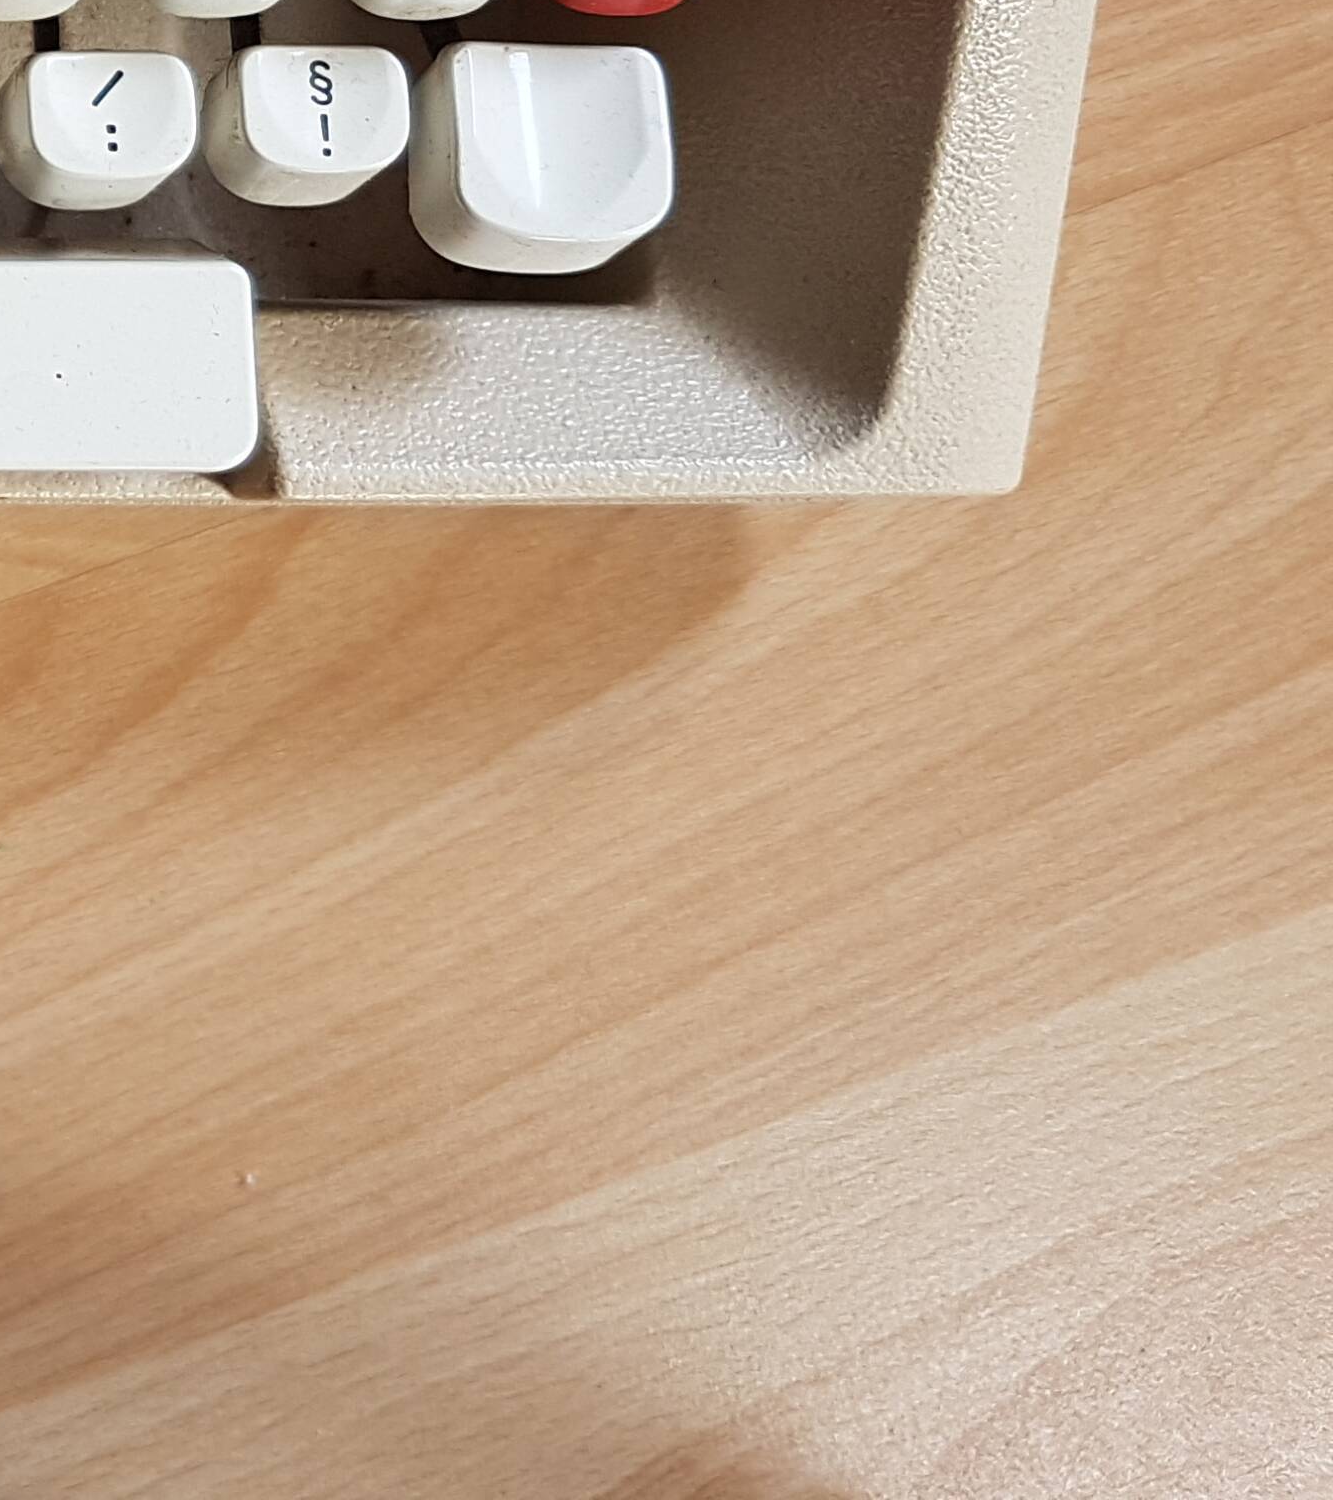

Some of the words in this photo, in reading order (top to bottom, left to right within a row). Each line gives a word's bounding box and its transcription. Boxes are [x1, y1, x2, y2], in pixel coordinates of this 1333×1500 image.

[92, 70, 124, 107] /
[309, 59, 333, 106] §
[319, 113, 332, 157] !
